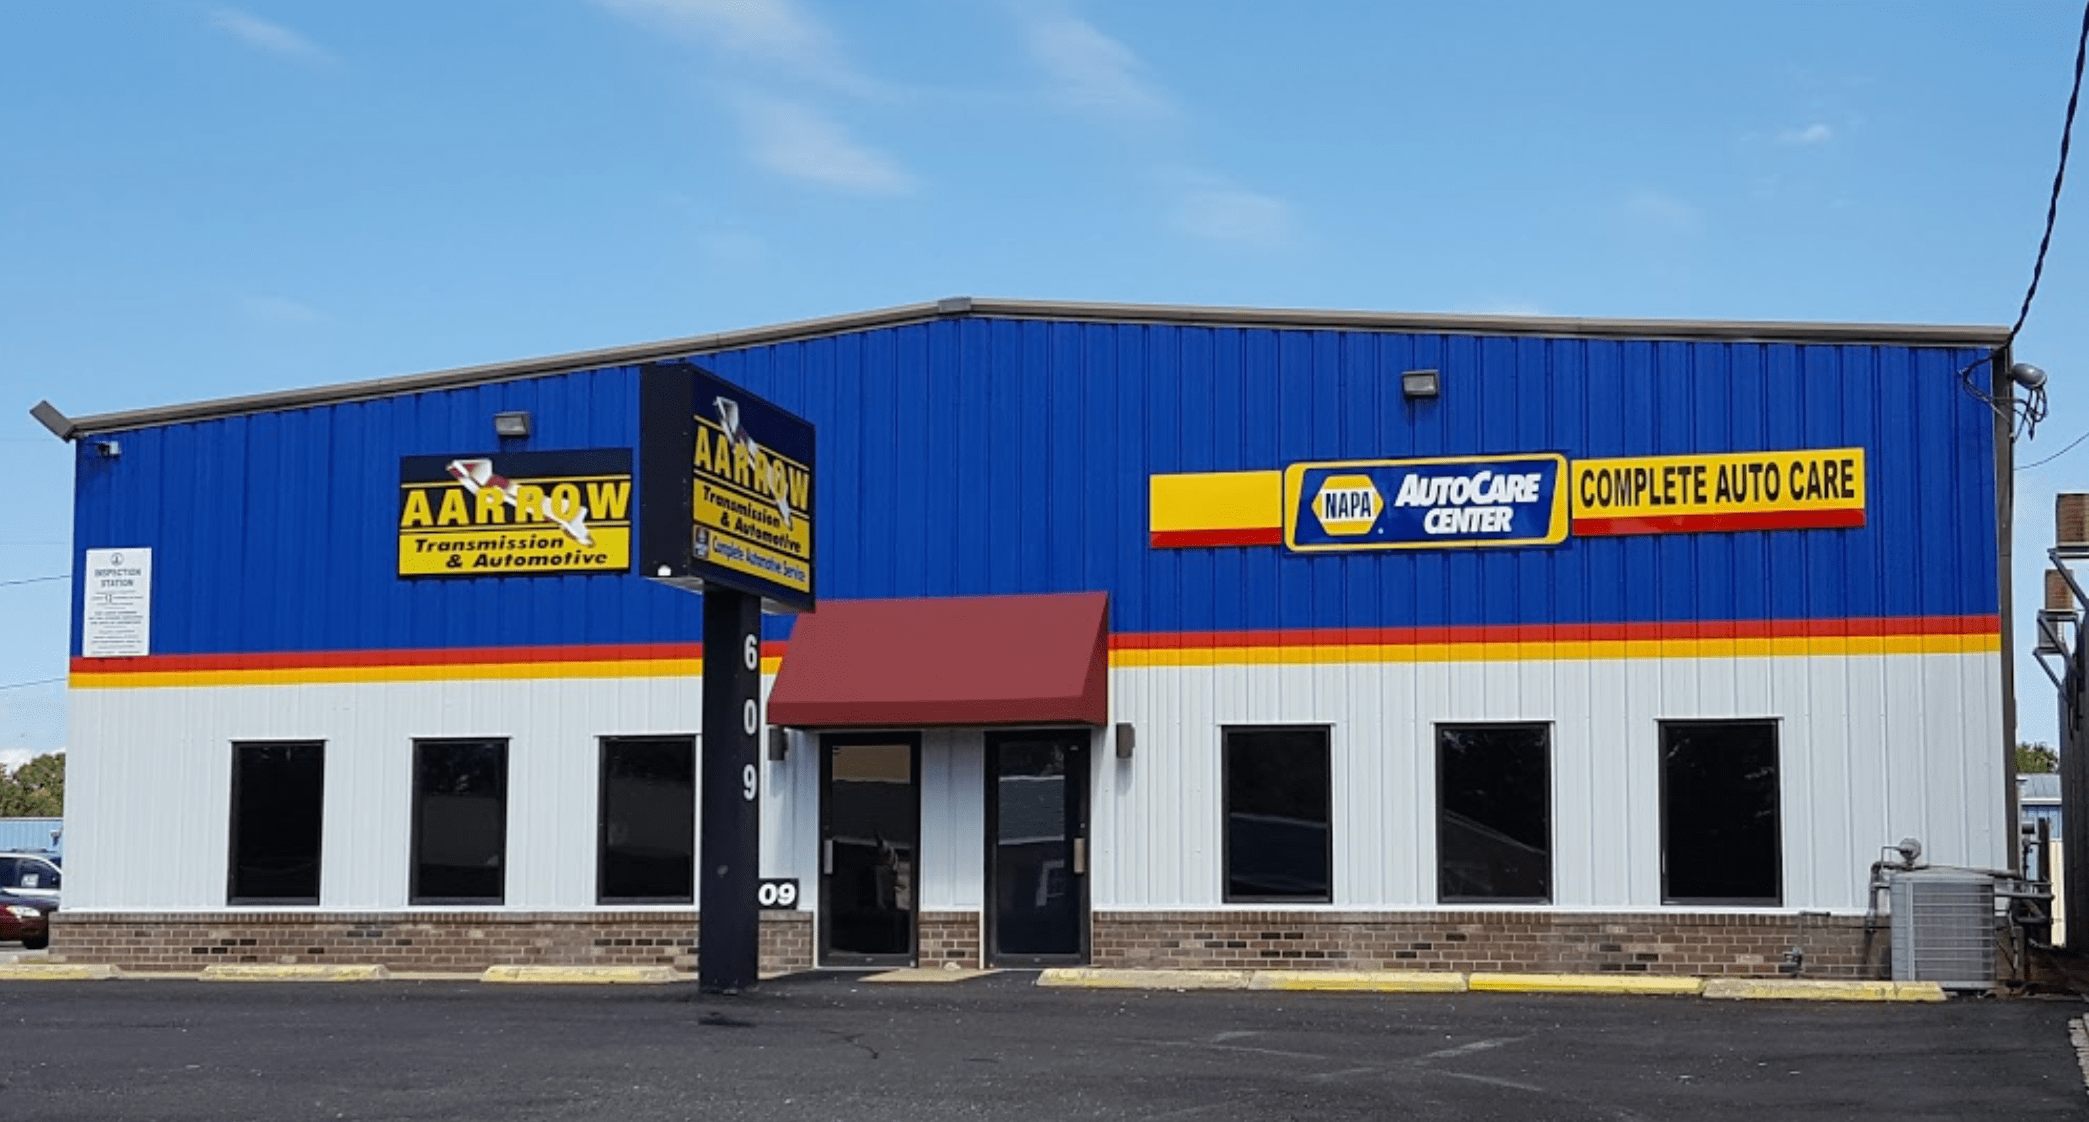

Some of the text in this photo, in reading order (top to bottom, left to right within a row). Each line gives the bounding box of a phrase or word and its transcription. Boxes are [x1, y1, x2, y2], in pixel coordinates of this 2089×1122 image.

[694, 424, 810, 511] AARROW
[1580, 459, 1854, 508] COMPLETE AUTO CARE
[401, 482, 631, 526] AARROW
[703, 484, 780, 529] Transmission
[1325, 486, 1371, 519] NAPA
[1424, 506, 1513, 534] CENTER
[415, 534, 564, 553] Transmission
[720, 511, 730, 527] &
[735, 516, 801, 553] Automotive
[446, 550, 608, 568] & Automotive
[101, 579, 134, 588] STATION
